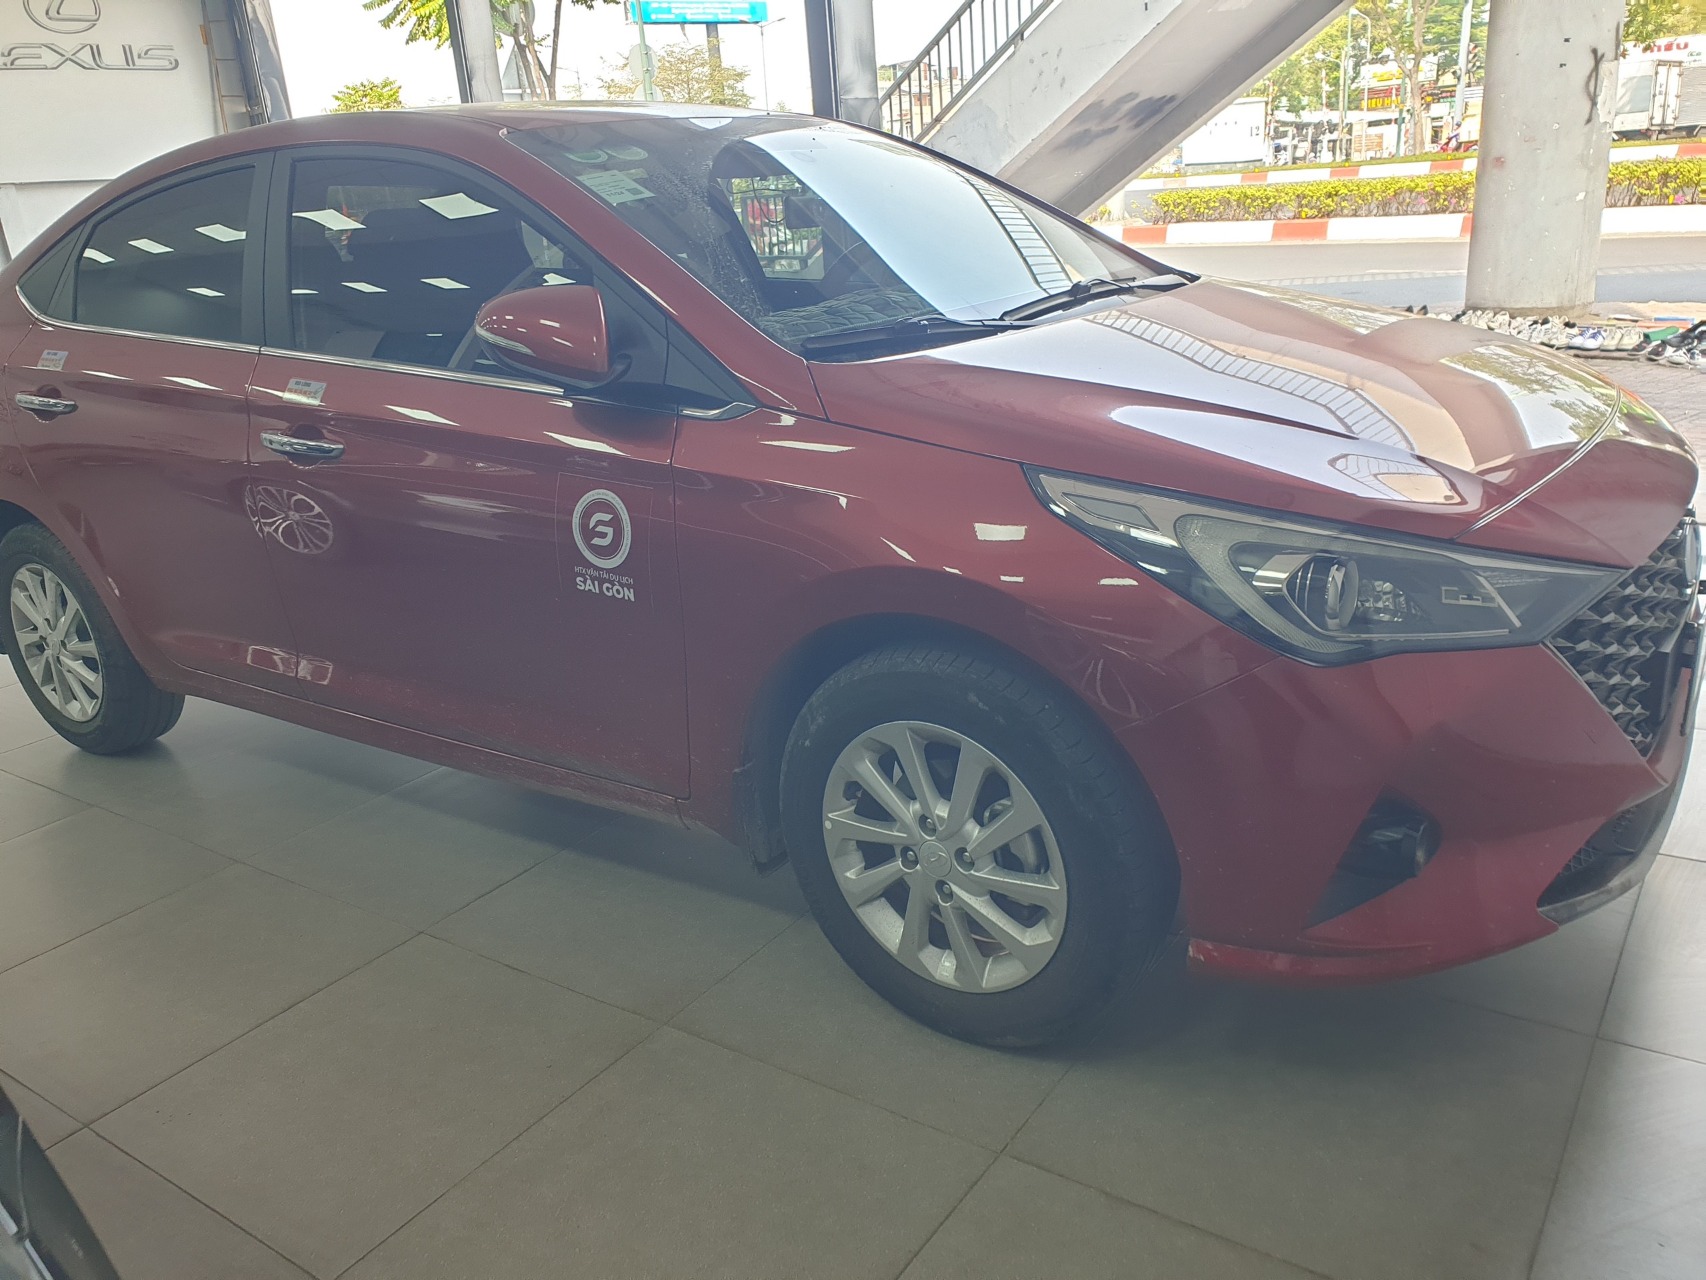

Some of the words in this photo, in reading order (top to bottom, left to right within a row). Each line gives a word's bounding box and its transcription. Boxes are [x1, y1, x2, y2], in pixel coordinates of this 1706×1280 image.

[574, 566, 586, 575] HTX
[619, 575, 634, 585] LỊCH
[576, 575, 599, 594] SÀI
[602, 581, 635, 602] GÒN
